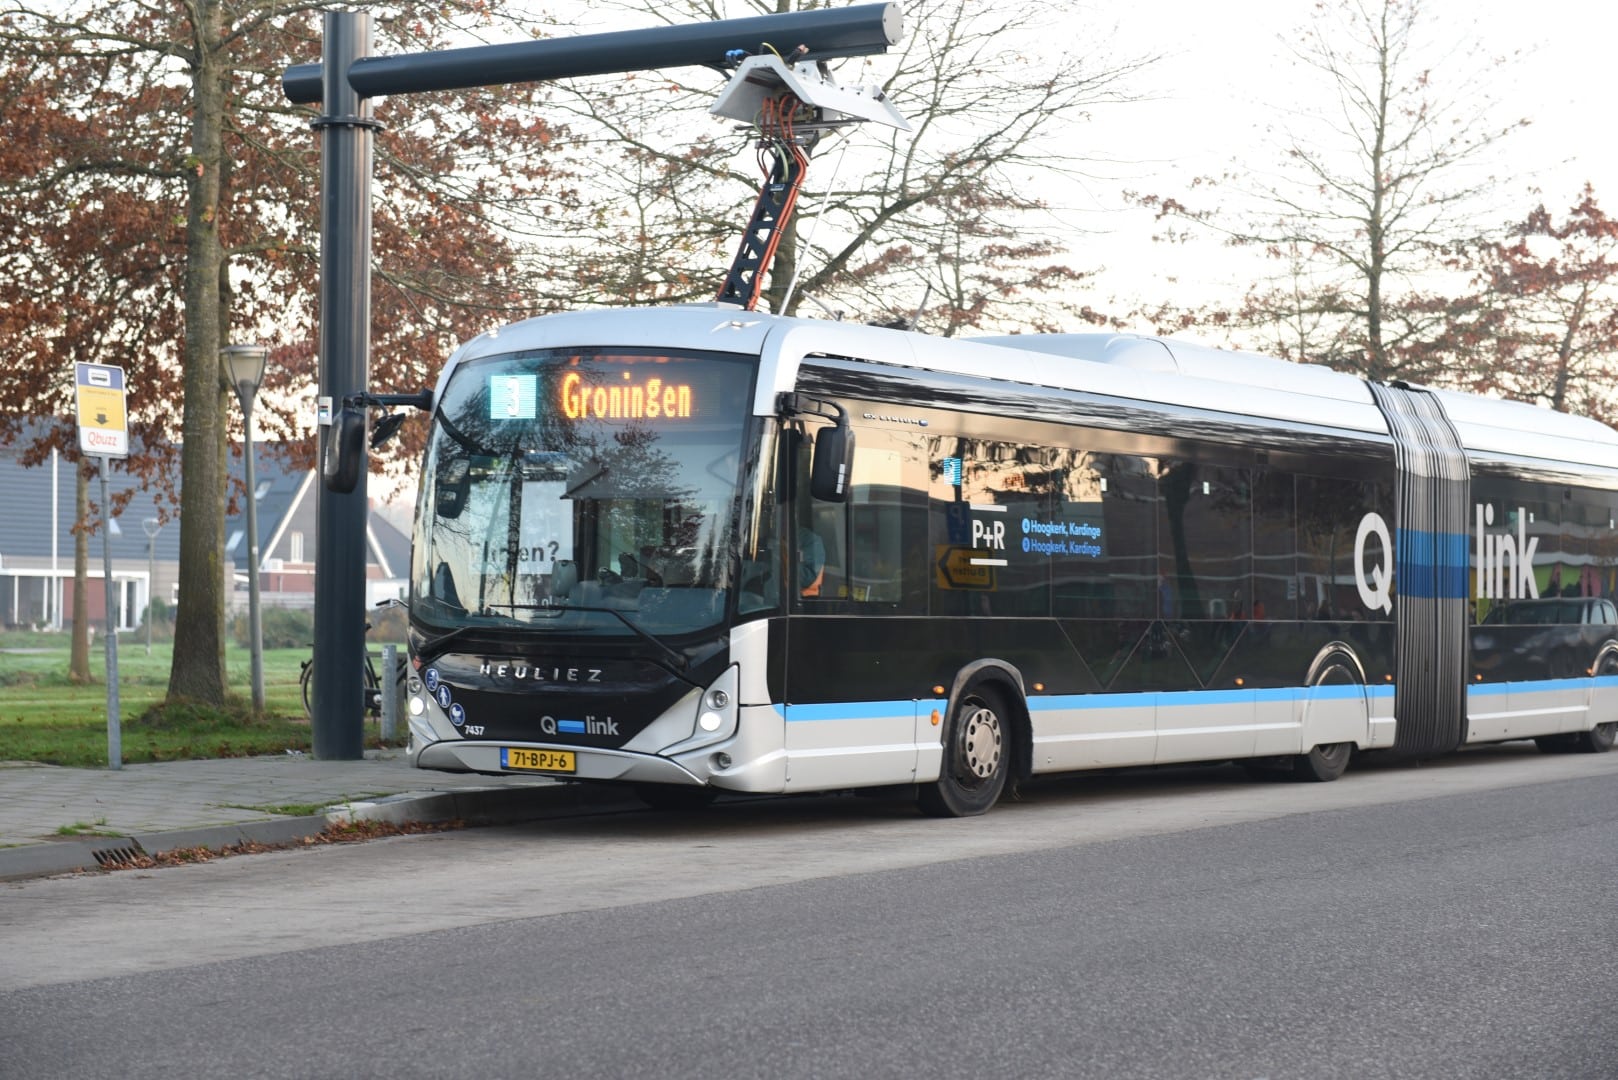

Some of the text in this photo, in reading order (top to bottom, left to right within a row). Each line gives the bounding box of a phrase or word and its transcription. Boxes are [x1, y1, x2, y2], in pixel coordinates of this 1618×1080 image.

[506, 372, 691, 419] 3 Groningen
[88, 431, 117, 446] Qbuzz
[972, 519, 1005, 550] P+R
[1030, 519, 1068, 537] Hoogkerk,
[1069, 522, 1101, 540] Kardinge
[1030, 538, 1068, 556] Hoogkerk,
[1069, 541, 1101, 558] Kardinge
[1354, 503, 1540, 617] Q link
[479, 664, 602, 682] HEULIEZ
[464, 725, 485, 736] 7437
[540, 715, 620, 736] Q link
[513, 751, 567, 768] 71-BPJ-6
